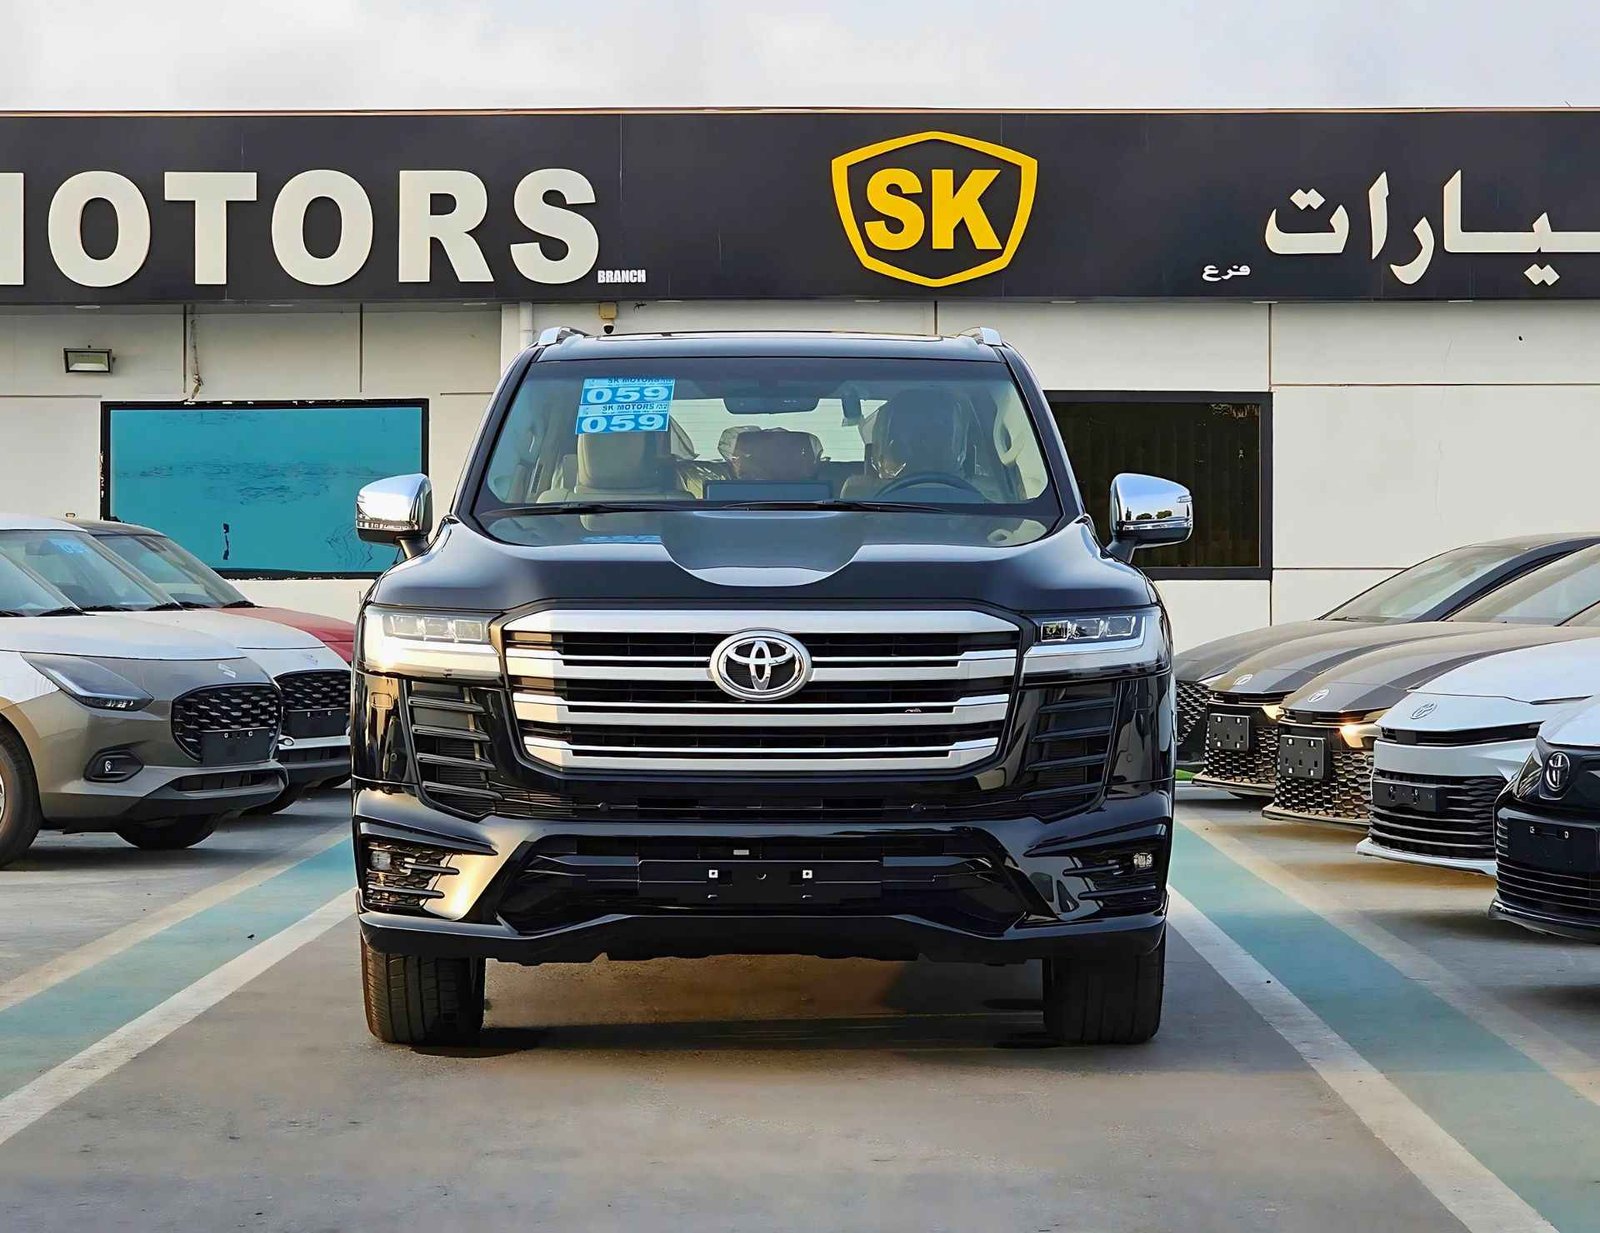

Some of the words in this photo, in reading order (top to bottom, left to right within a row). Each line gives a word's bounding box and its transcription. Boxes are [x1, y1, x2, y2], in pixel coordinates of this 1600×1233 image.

[864, 168, 1003, 250] SK
[0, 168, 600, 287] OTORS
[1265, 169, 1600, 286] يارات
[597, 269, 647, 284] BRANCH
[1202, 264, 1251, 282] فرع
[586, 386, 669, 404] 059
[601, 404, 614, 412] SK
[617, 403, 655, 411] MOTORS
[581, 414, 664, 433] 059
